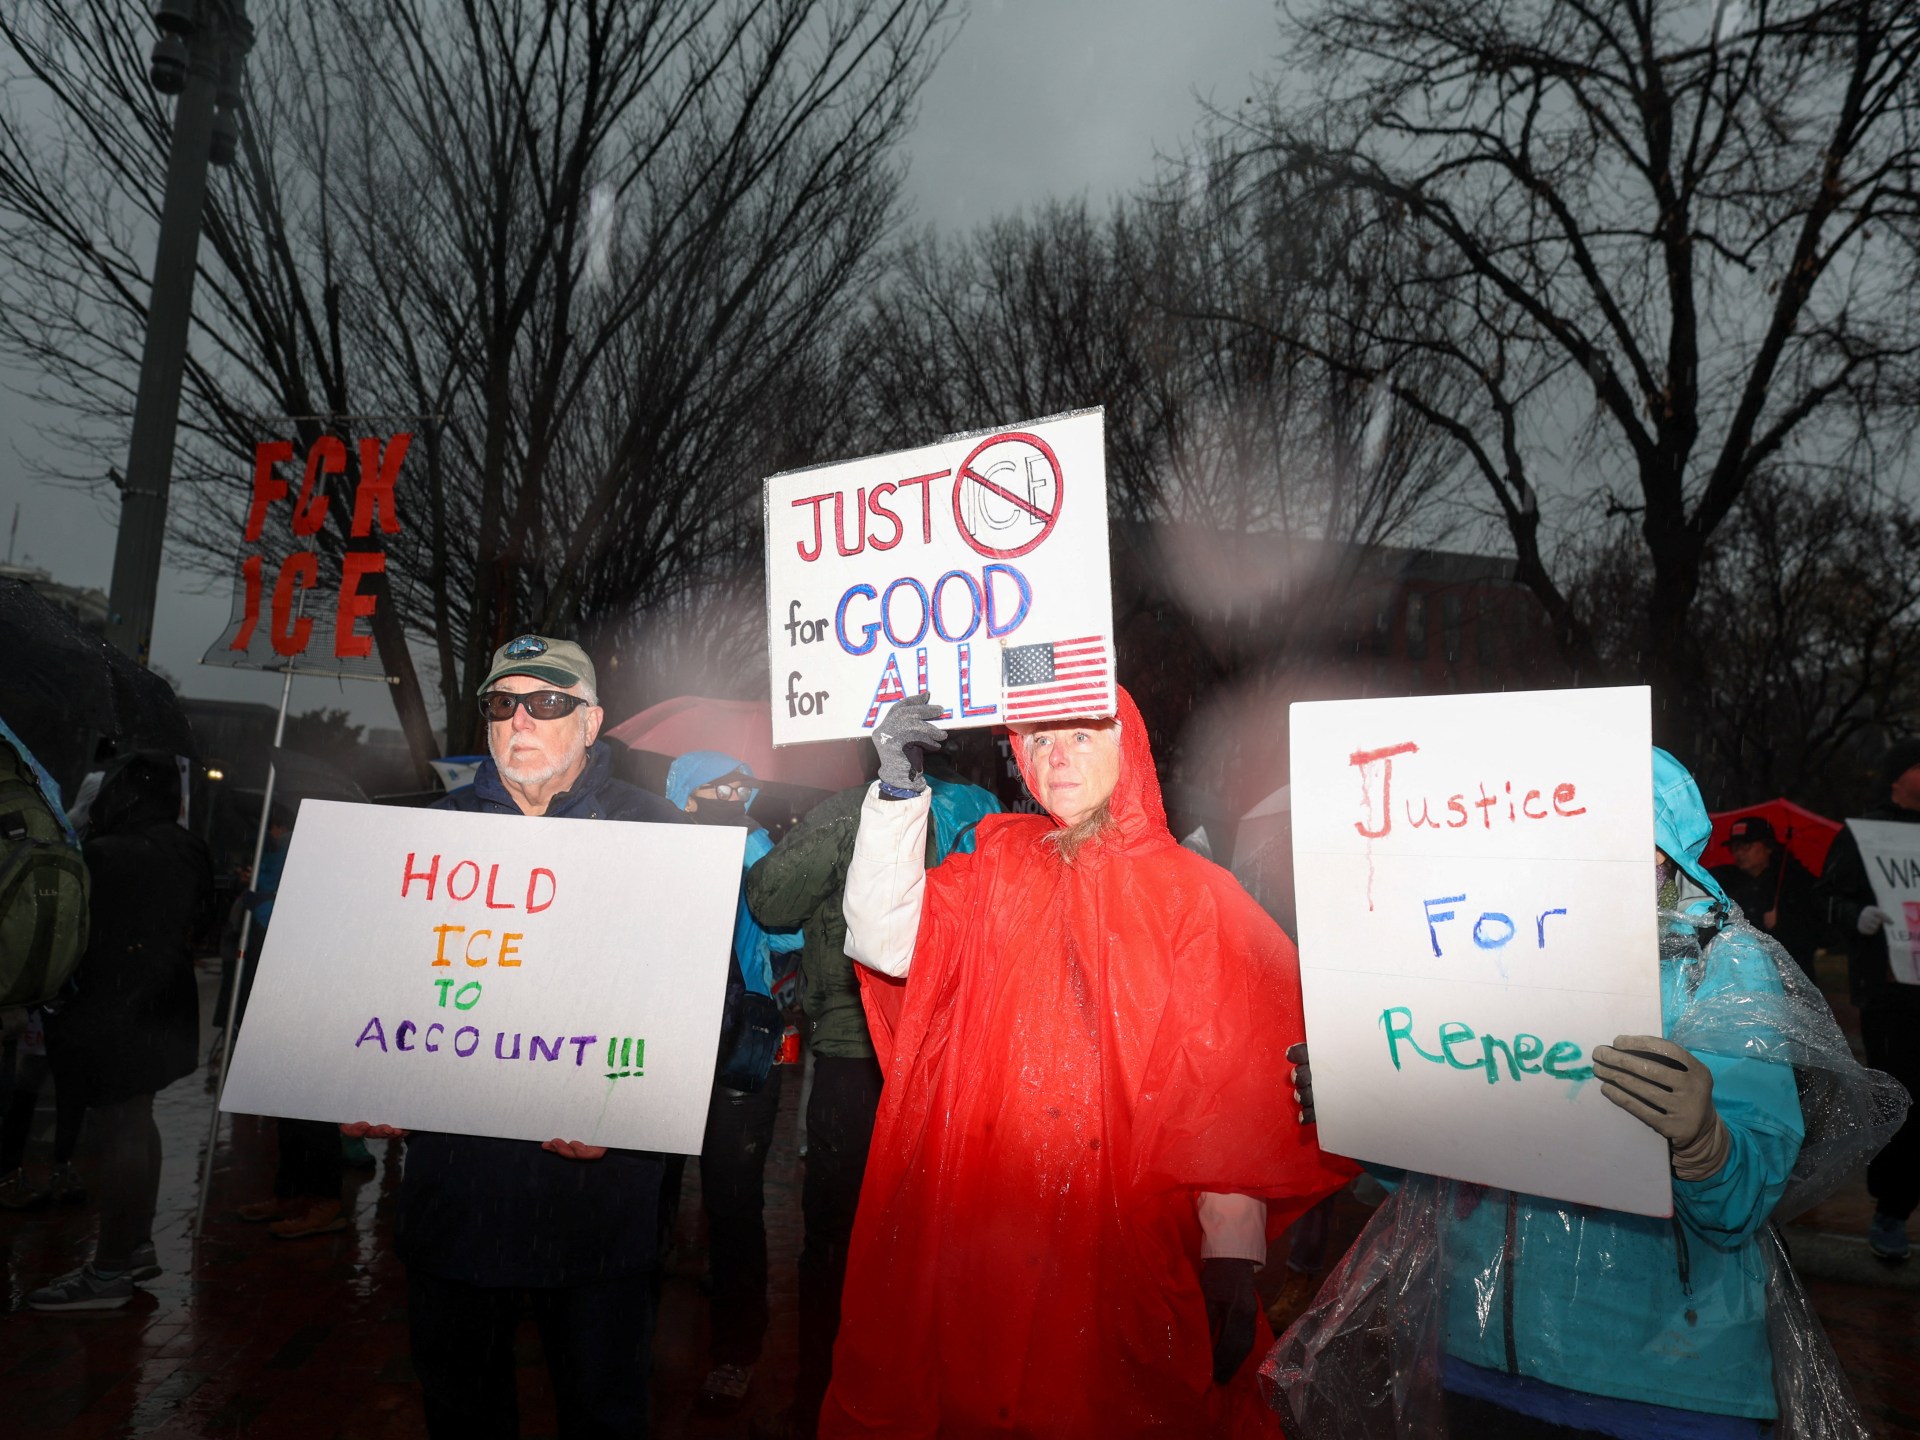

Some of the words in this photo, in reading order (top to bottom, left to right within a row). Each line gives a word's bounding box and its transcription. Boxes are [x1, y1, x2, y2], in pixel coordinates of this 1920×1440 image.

[791, 469, 952, 562] JUST
[965, 452, 1050, 537] ICE
[229, 551, 386, 657] ICE
[784, 599, 830, 647] for
[835, 563, 1032, 656] GOOD
[785, 670, 830, 718] for
[861, 642, 998, 728] ALL
[1349, 741, 1587, 838] Justice
[401, 852, 557, 914] HOLD
[431, 923, 524, 968] ICE
[1423, 894, 1567, 958] For
[434, 978, 482, 1011] TO
[1378, 1006, 1593, 1085] Renee
